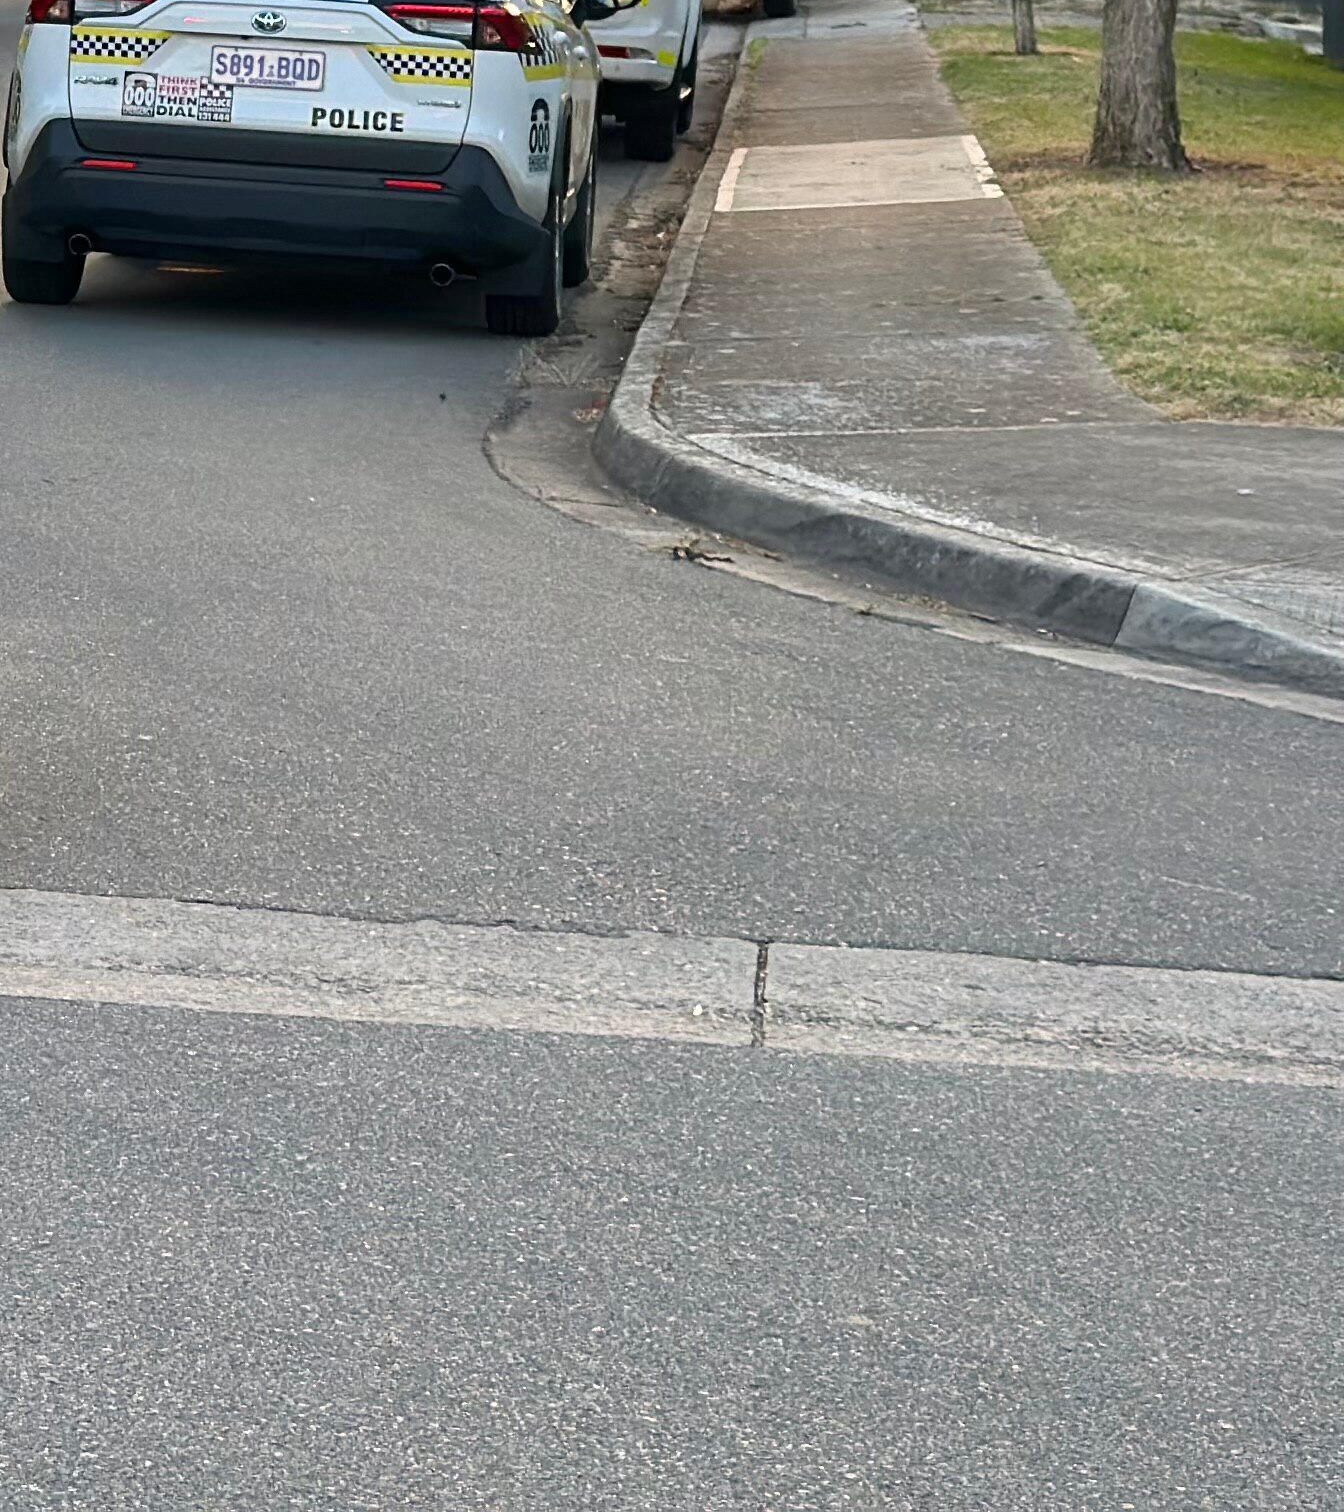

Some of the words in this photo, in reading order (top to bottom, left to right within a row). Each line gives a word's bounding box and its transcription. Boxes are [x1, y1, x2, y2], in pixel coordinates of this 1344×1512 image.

[215, 53, 265, 77] S891
[161, 76, 198, 86] THINK
[124, 86, 155, 106] 000
[159, 85, 198, 96] FIRST
[158, 95, 197, 106] THEN
[156, 105, 196, 118] DIAL
[311, 107, 405, 132] POLICE
[529, 123, 550, 154] 000
